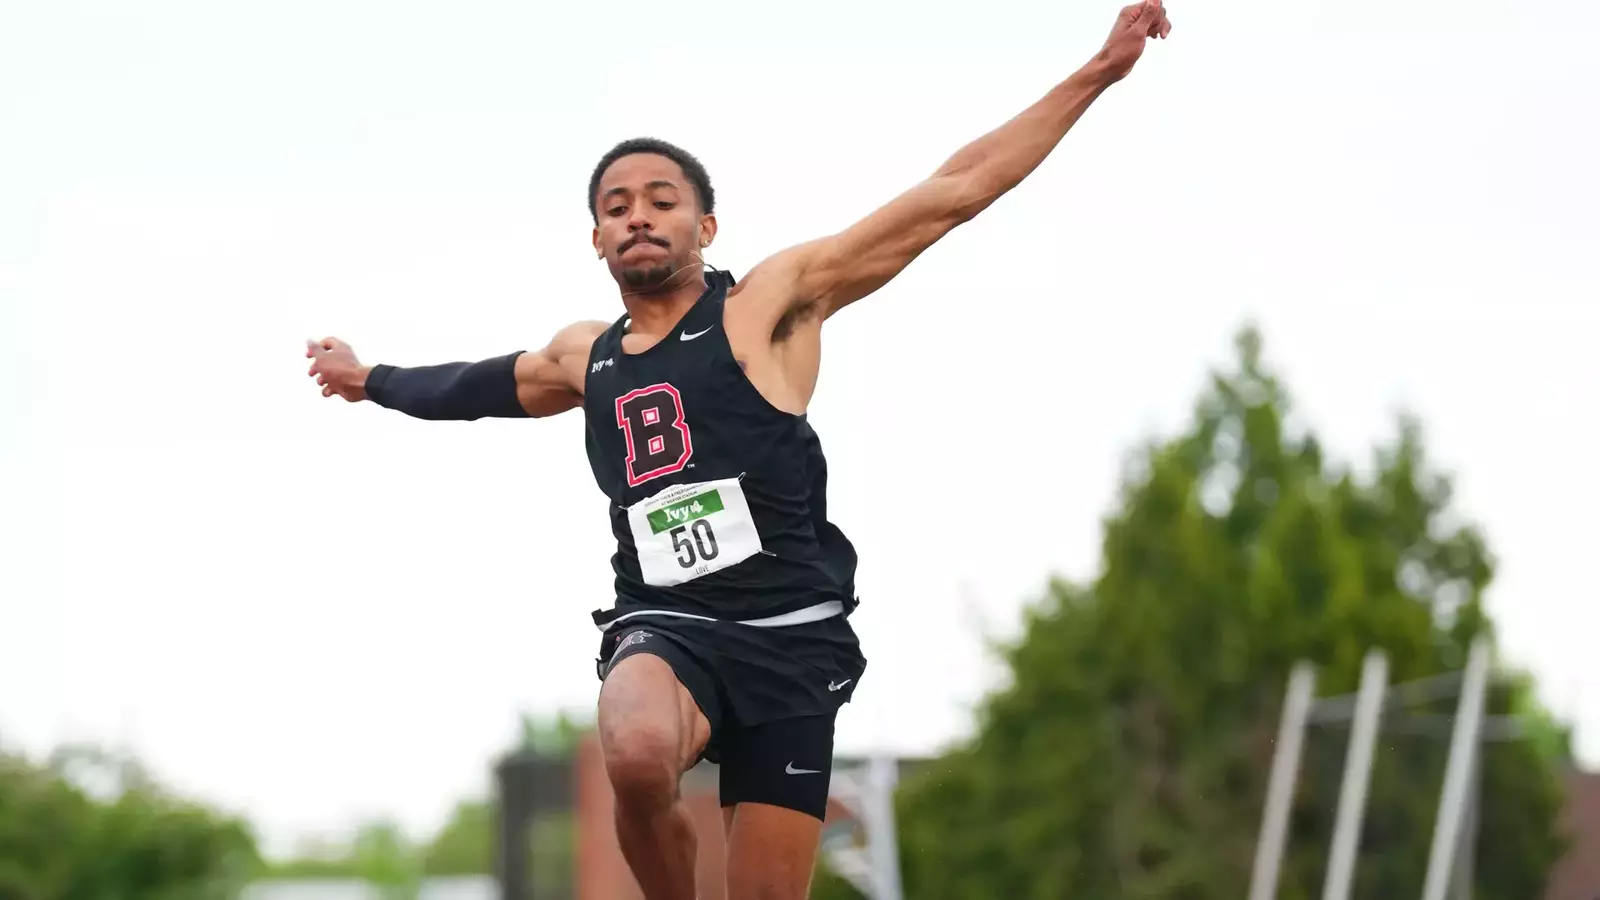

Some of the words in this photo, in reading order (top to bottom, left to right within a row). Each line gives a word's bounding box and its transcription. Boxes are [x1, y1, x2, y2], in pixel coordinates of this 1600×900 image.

[591, 360, 605, 373] Ivy
[615, 382, 693, 488] B
[664, 506, 689, 522] Ivy
[670, 519, 719, 568] 50
[695, 566, 709, 574] LOVE
